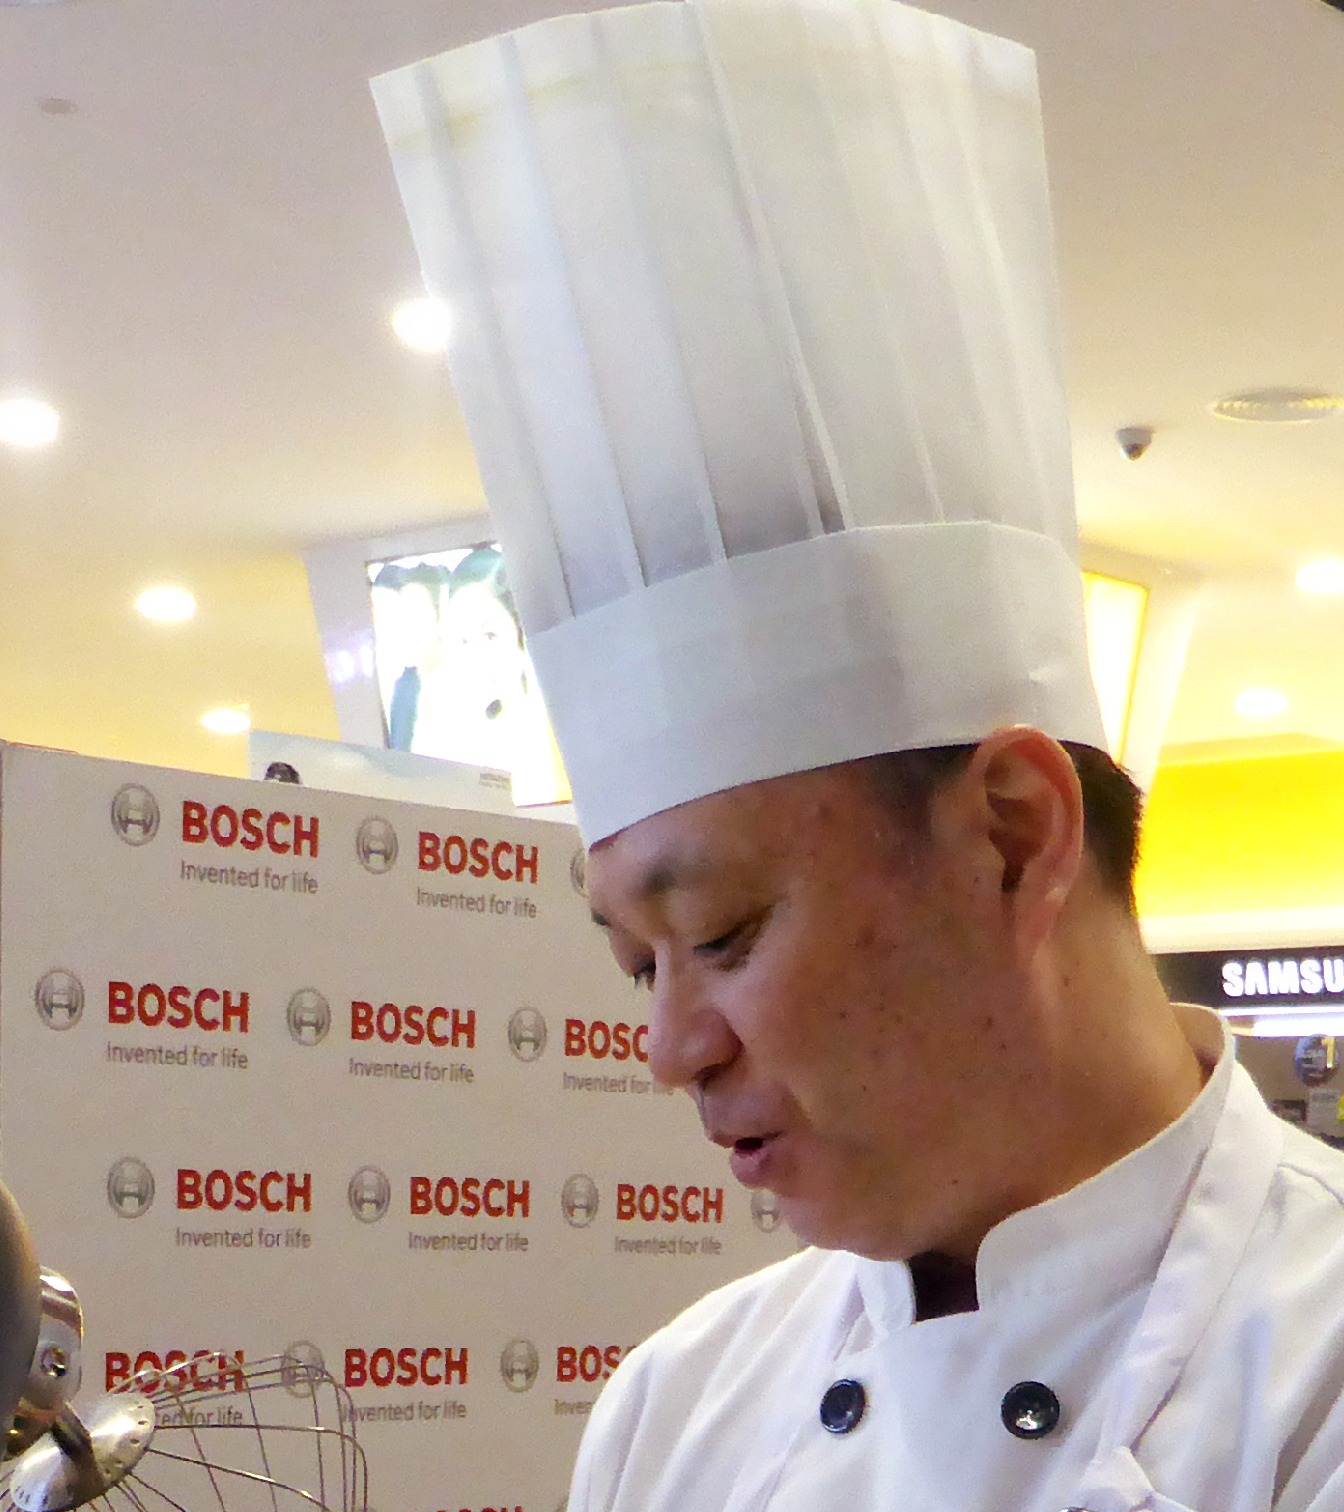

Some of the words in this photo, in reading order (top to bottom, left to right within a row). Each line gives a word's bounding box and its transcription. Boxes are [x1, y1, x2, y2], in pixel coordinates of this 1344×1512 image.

[181, 800, 320, 858] BOSCH
[181, 859, 258, 888] Invented
[264, 867, 288, 891] for
[292, 870, 318, 894] life
[418, 832, 539, 884] BOSCH
[417, 887, 484, 914] Invented
[490, 893, 510, 916] for
[513, 896, 537, 918] life
[108, 982, 250, 1033] BOSCH
[350, 1002, 476, 1048] BOSCH
[107, 1041, 187, 1066] Invented
[193, 1046, 217, 1068] for
[222, 1047, 248, 1069] life
[564, 1018, 649, 1063] BOSC
[349, 1057, 421, 1080] Invented
[425, 1061, 448, 1082] for
[450, 1063, 474, 1083] life
[177, 1169, 312, 1213] BOSCH
[410, 1176, 531, 1218] BOSCH
[616, 1183, 724, 1223] BOSCH
[176, 1227, 254, 1249] Invented
[258, 1227, 281, 1248] for
[285, 1229, 311, 1249] life
[408, 1231, 478, 1251] Invented
[481, 1233, 502, 1252] for
[505, 1233, 528, 1253] life
[615, 1235, 675, 1253] Invented
[678, 1237, 696, 1255] for
[698, 1237, 721, 1256] life
[105, 1350, 244, 1394] BOSCH
[344, 1347, 469, 1389] BOSCH
[556, 1345, 626, 1382] BOS
[217, 1405, 243, 1425] life
[342, 1402, 414, 1422] Invented
[419, 1401, 440, 1420] for
[443, 1399, 467, 1419] life
